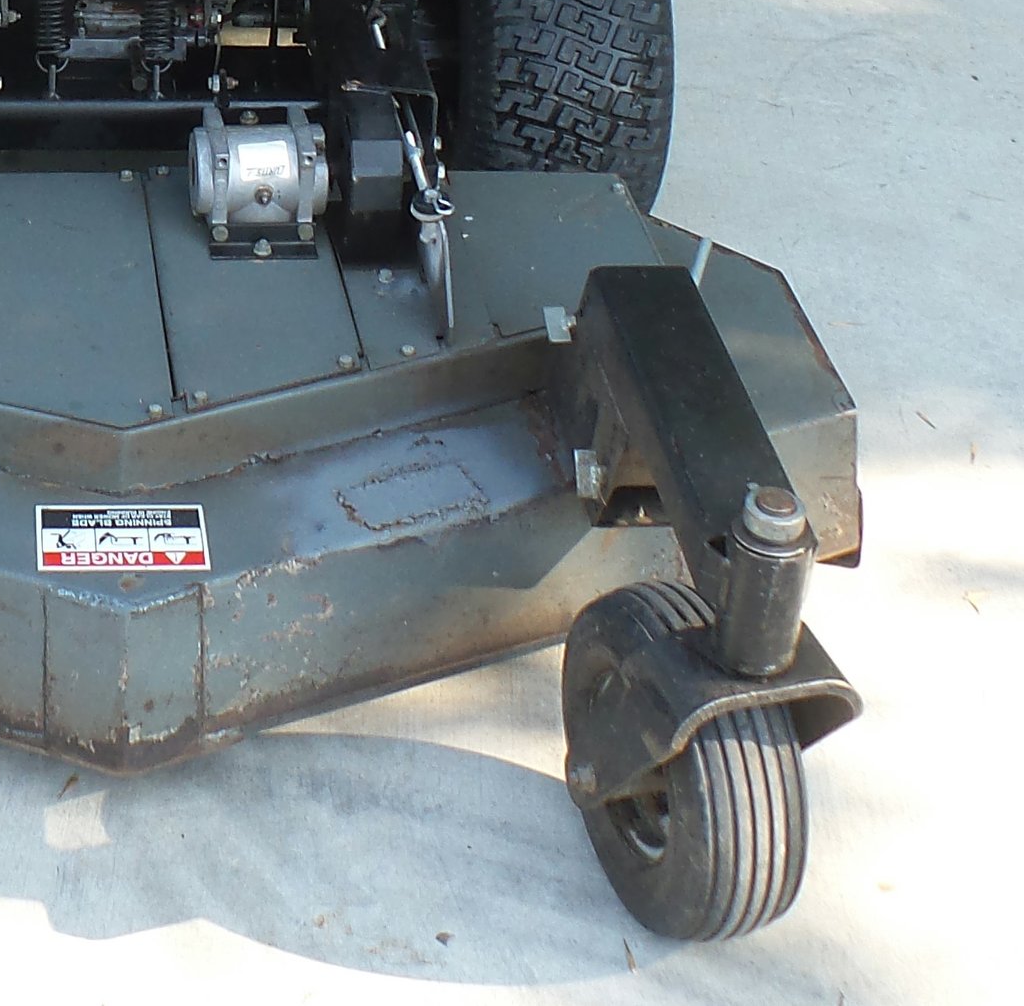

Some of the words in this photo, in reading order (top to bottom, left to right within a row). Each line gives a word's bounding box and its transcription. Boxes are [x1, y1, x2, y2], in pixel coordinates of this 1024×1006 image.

[71, 518, 112, 527] BLADE
[114, 518, 172, 527] SPINNING
[61, 551, 154, 566] DANGER
